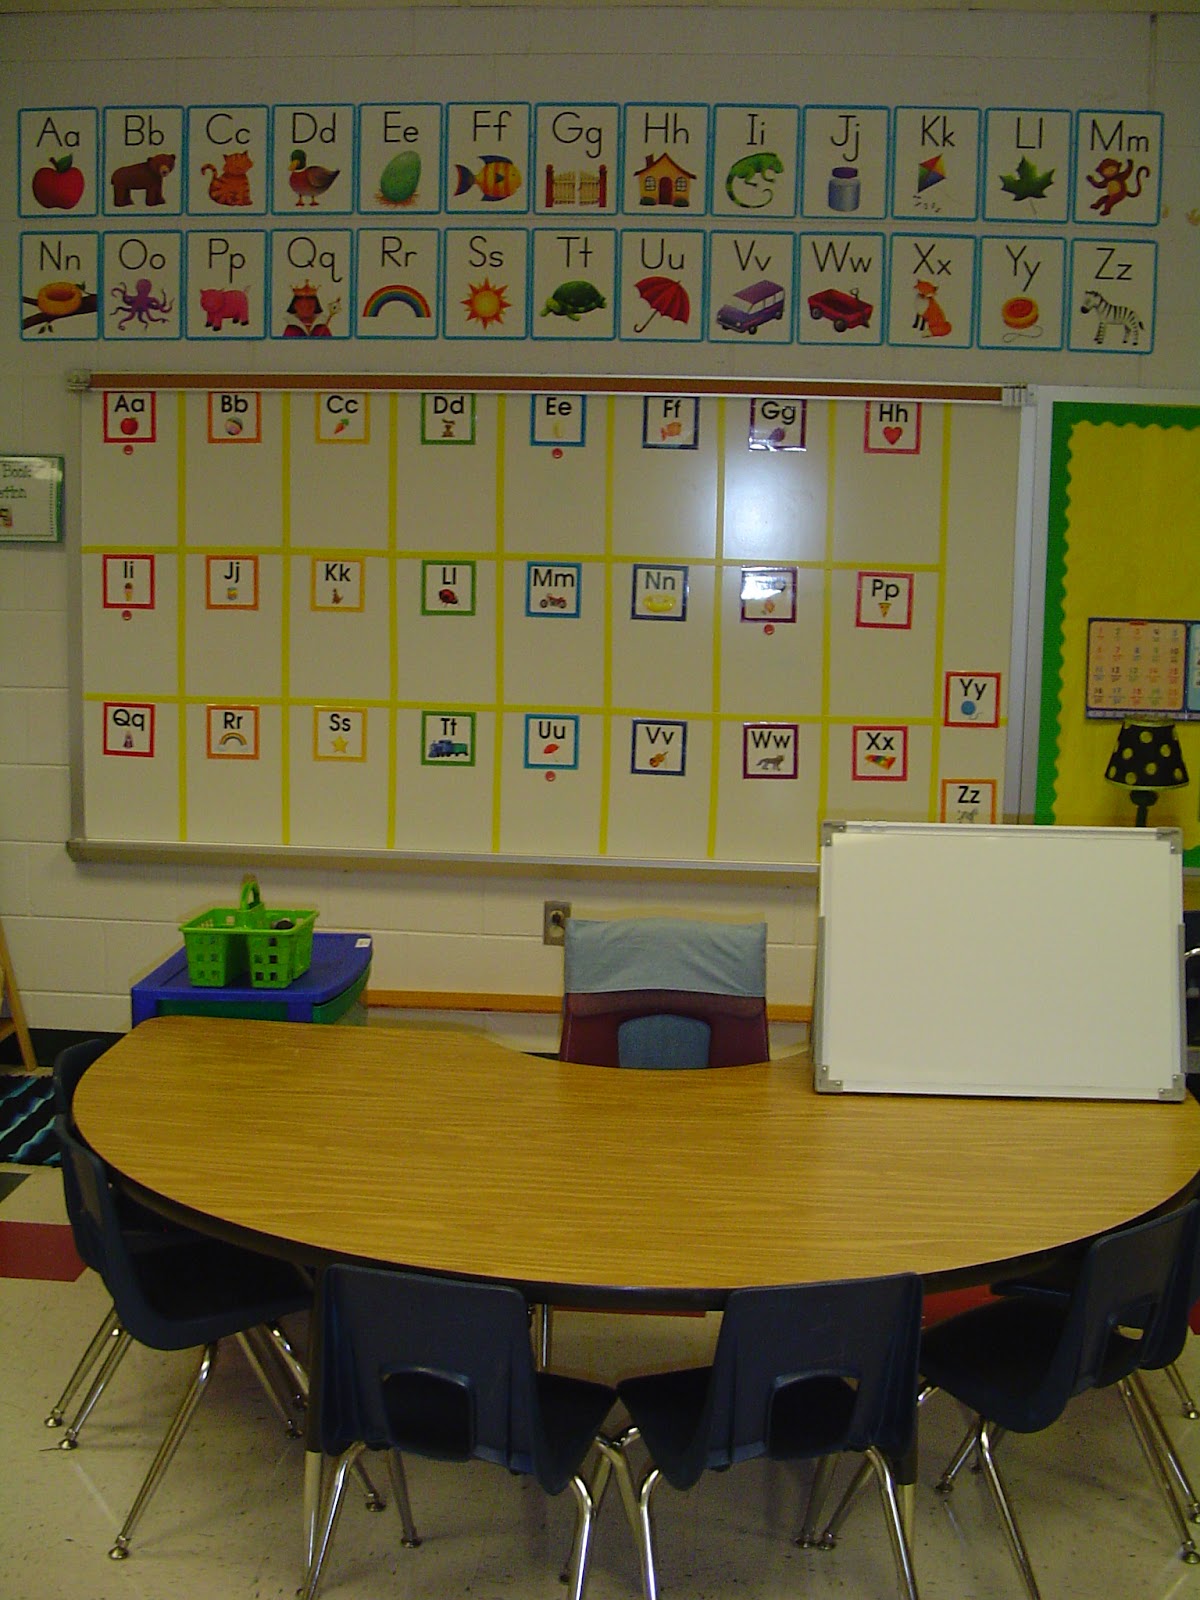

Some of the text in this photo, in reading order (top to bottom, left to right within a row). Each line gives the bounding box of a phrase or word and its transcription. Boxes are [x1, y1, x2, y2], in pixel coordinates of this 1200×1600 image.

[36, 116, 80, 148] Aa
[124, 114, 165, 147] Bb
[205, 113, 251, 145] Cc
[292, 111, 336, 144] Dd
[383, 110, 419, 143] Ee
[473, 110, 512, 142] Ff
[552, 111, 602, 159] Gg
[644, 112, 690, 144] Hh
[746, 113, 765, 146] Ii
[830, 114, 860, 163] Jj
[921, 114, 956, 147] Kk
[1016, 116, 1044, 150] Ll
[1090, 119, 1150, 153] Mm
[39, 240, 81, 271] Nn
[118, 238, 166, 271] Oo
[208, 237, 246, 284] Pp
[287, 236, 343, 283] Qq
[381, 235, 418, 268] Rr
[469, 235, 504, 268] Ss
[556, 236, 593, 268] Tt
[641, 238, 685, 271] Uu
[733, 239, 772, 272] Vv
[811, 241, 872, 273] Ww
[912, 242, 952, 276] Xx
[1094, 247, 1133, 281] Zz
[1005, 244, 1041, 293] Yy
[114, 394, 145, 413] Aa
[221, 394, 249, 413] Bb
[326, 394, 359, 414] Cc
[433, 395, 465, 415] Dd
[546, 396, 572, 416] Ee
[663, 399, 682, 419] Ff
[761, 400, 797, 426] Gg
[879, 403, 908, 423] Hh
[123, 560, 134, 579] Ii
[223, 561, 240, 584] Jj
[325, 563, 351, 582] Kk
[442, 566, 457, 585] Ll
[533, 568, 575, 588] Mm
[645, 570, 676, 591] Nn
[871, 578, 900, 602] Pp
[959, 678, 987, 701] Yy
[112, 706, 147, 732] Qq
[223, 711, 244, 730] Rr
[329, 713, 351, 732] Ss
[440, 717, 458, 736] Tt
[538, 720, 566, 740] Uu
[645, 726, 675, 745] Vv
[750, 730, 791, 749] Ww
[866, 732, 895, 751] Xx
[957, 785, 981, 804] Zz
